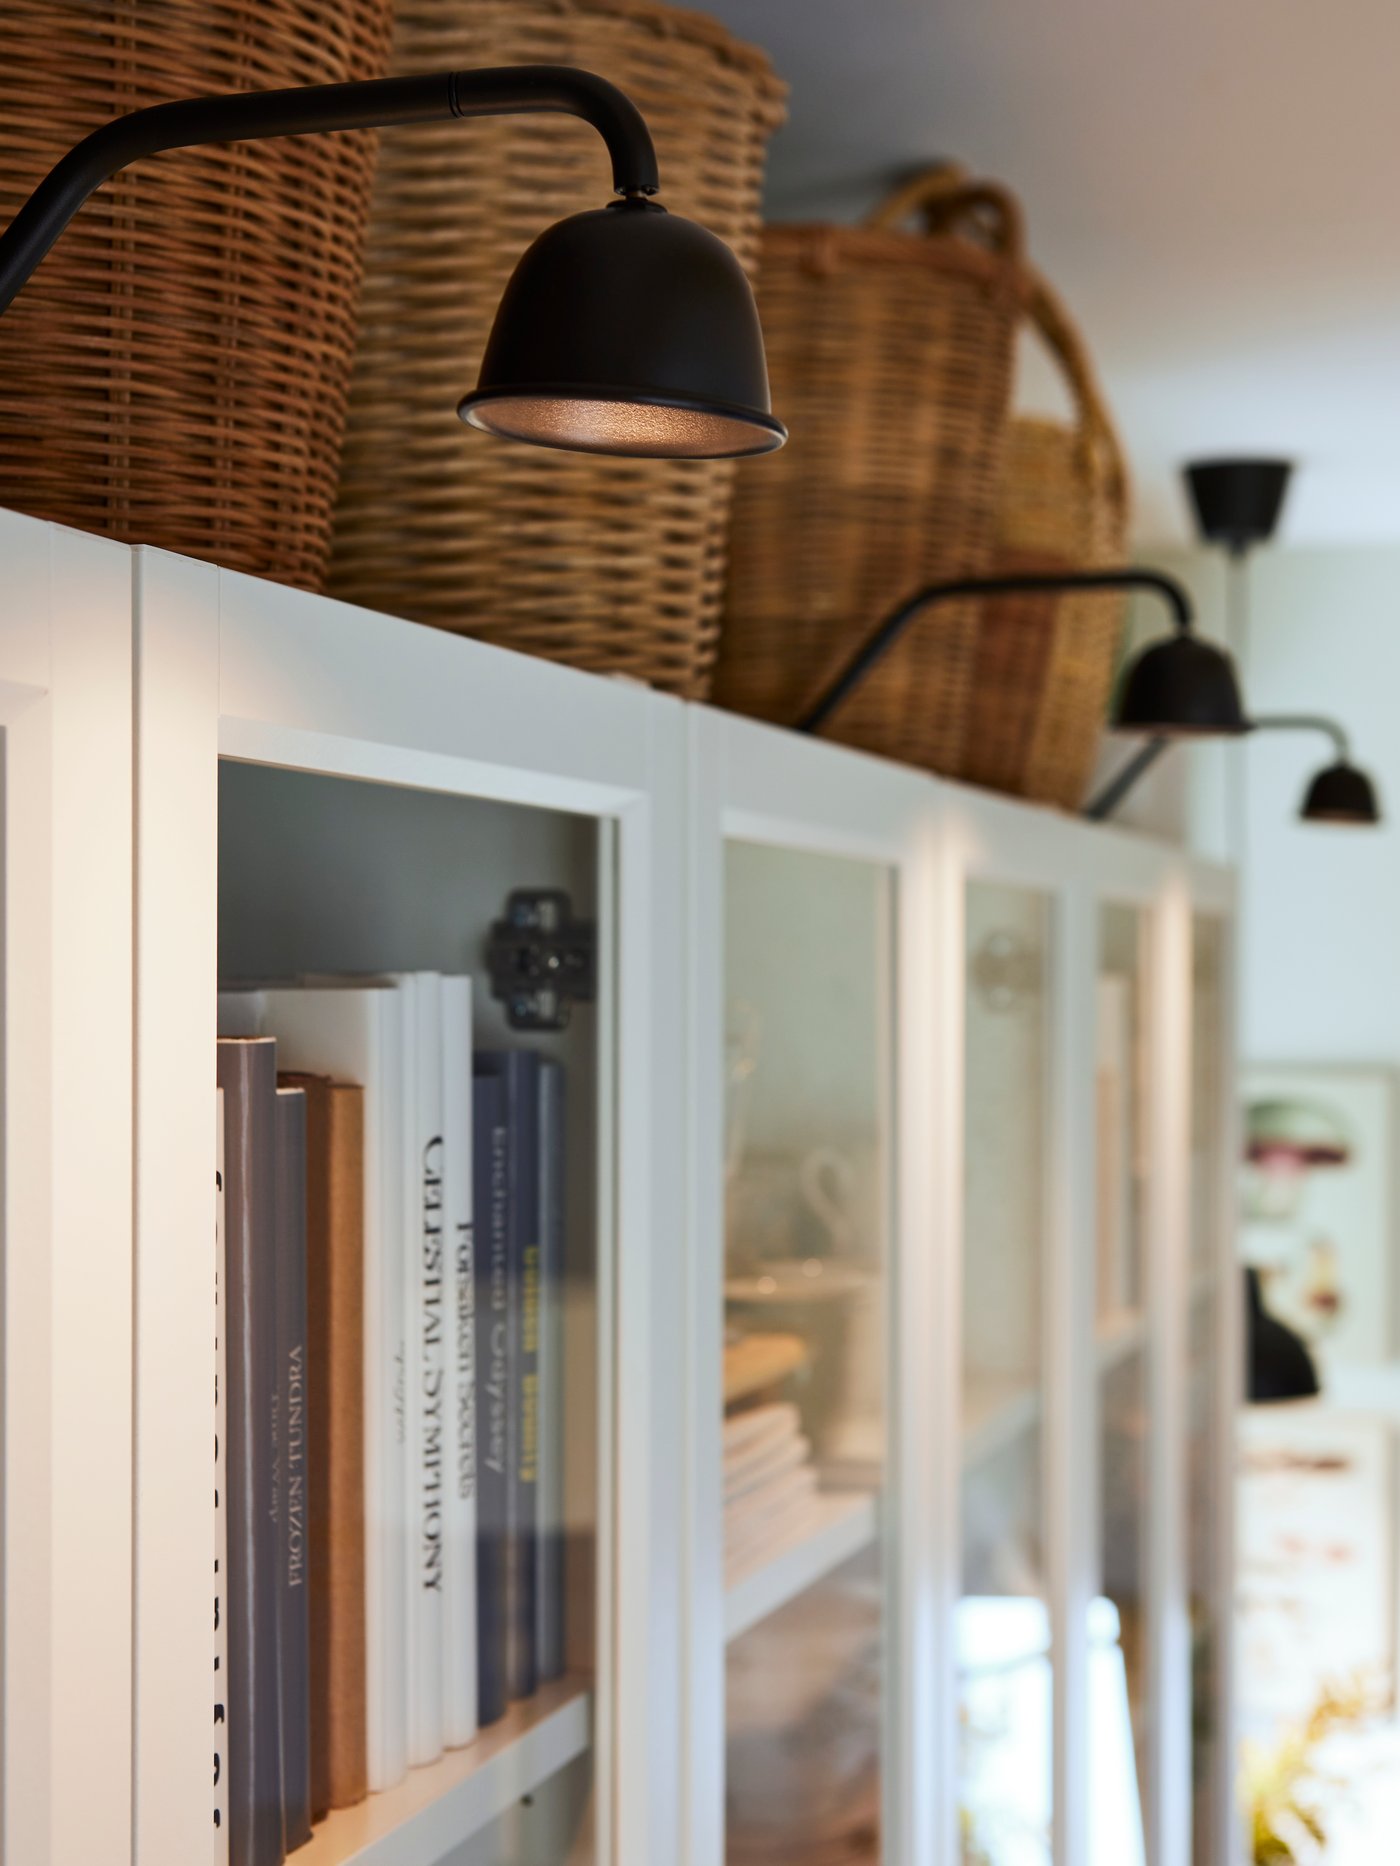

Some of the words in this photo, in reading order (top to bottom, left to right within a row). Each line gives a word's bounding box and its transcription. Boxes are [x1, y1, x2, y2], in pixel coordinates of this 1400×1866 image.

[422, 1135, 444, 1362] CELESTIAL
[287, 1345, 304, 1469] TUNDRA
[422, 1368, 444, 1593] SYMPHONY
[287, 1476, 304, 1586] FROZEN
